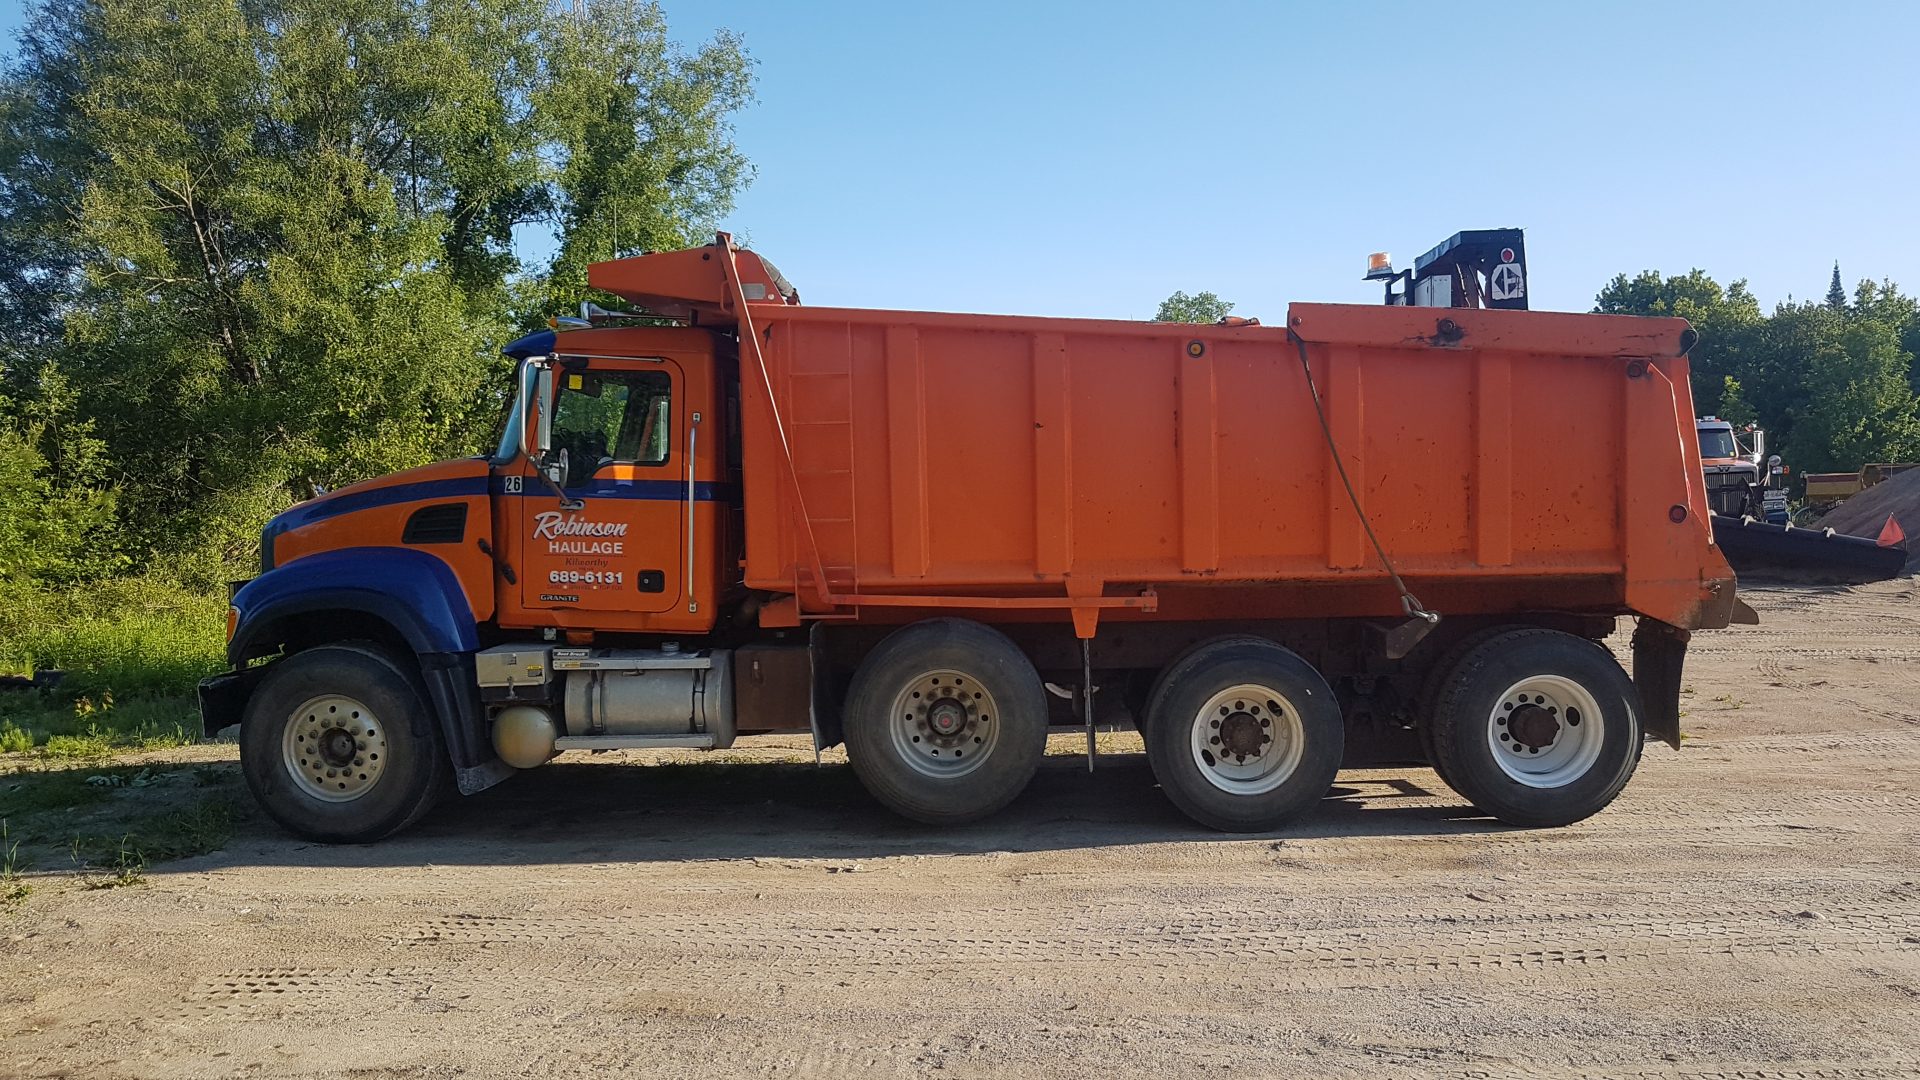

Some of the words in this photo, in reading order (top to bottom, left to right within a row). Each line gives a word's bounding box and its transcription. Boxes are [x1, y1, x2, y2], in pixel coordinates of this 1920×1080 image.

[506, 477, 521, 492] 26
[533, 511, 628, 540] Robinson
[549, 542, 623, 554] HAULAGE
[565, 557, 609, 567] Kilworthy
[549, 570, 623, 584] 689-6131
